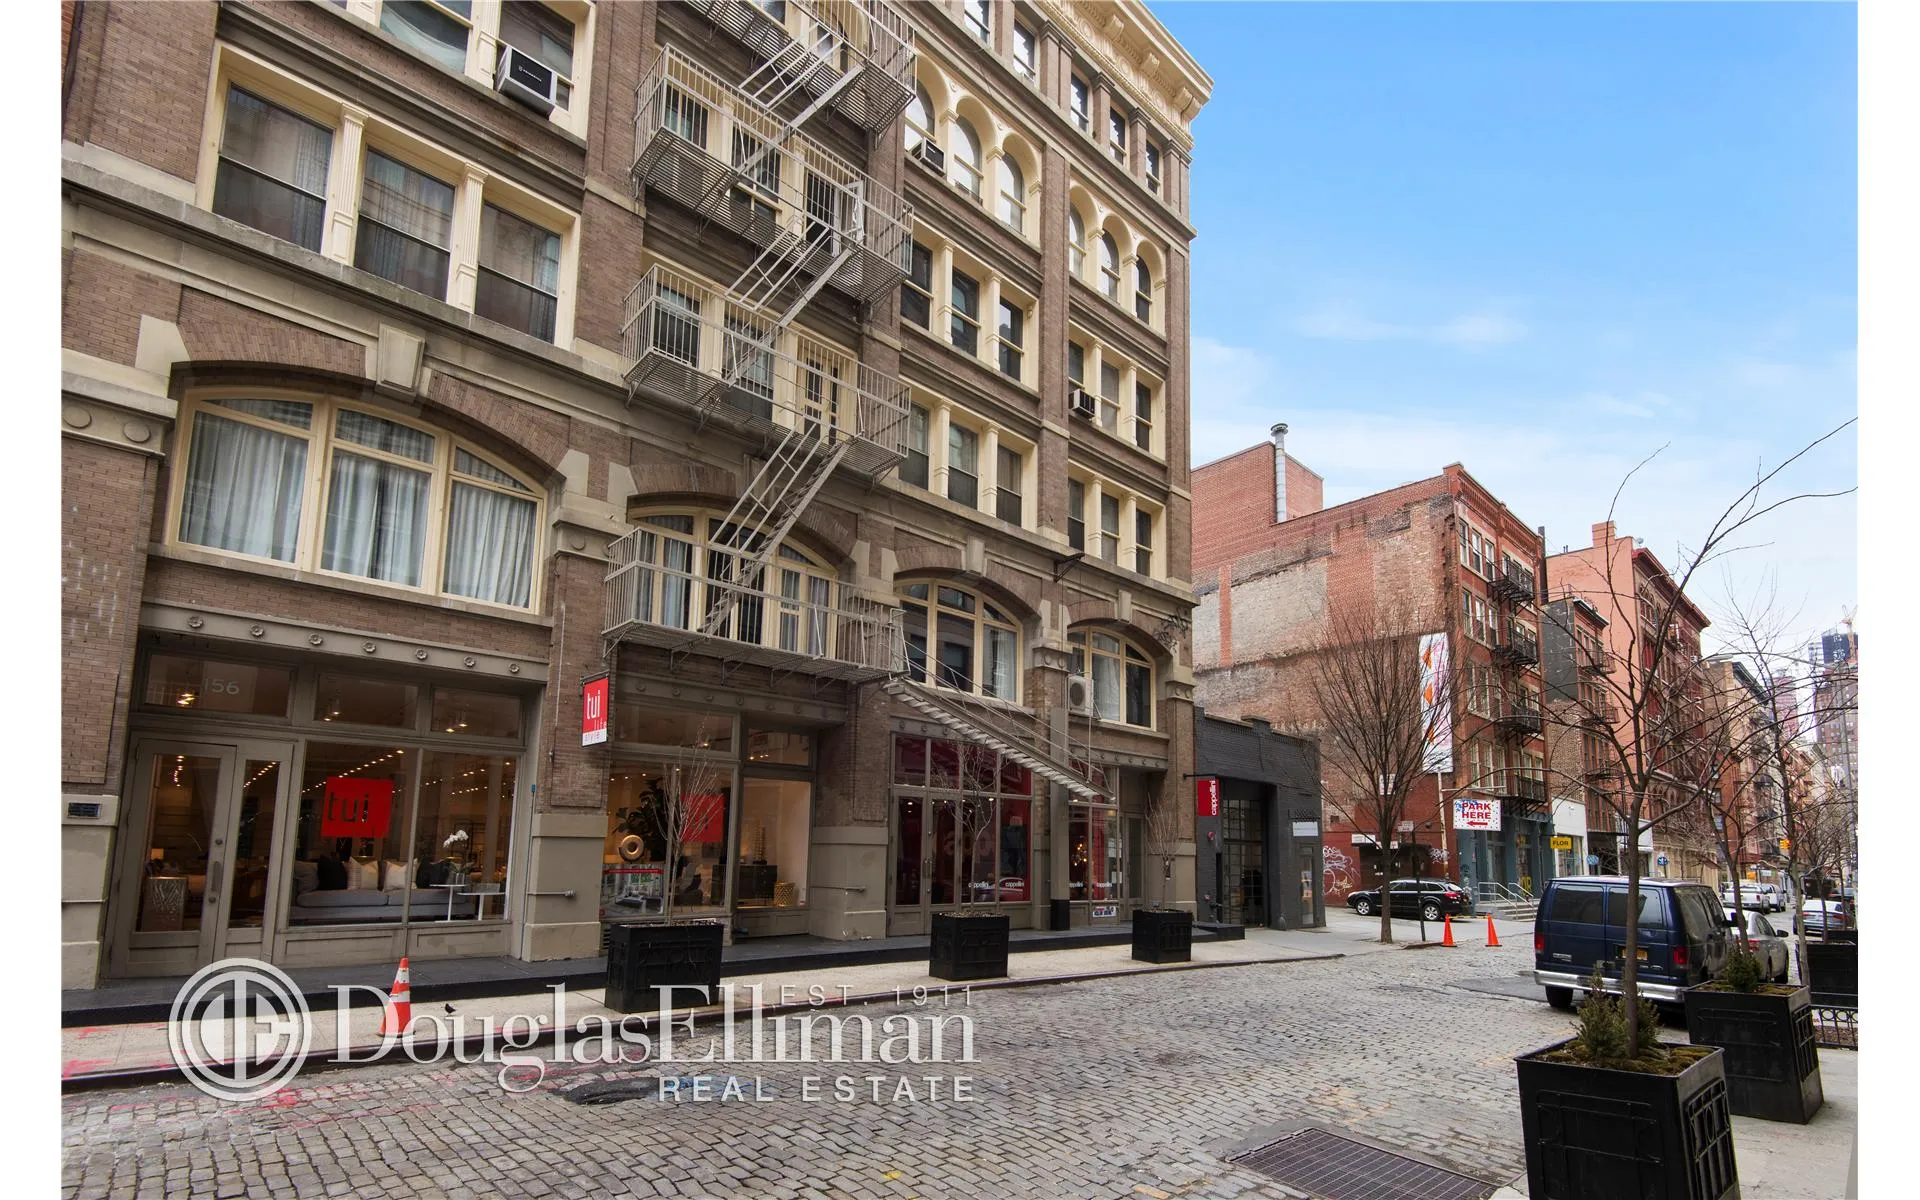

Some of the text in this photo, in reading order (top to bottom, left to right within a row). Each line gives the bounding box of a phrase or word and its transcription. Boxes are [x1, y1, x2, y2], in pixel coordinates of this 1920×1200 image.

[204, 678, 240, 695] 156
[587, 689, 601, 720] tui
[327, 792, 369, 823] tui
[1209, 778, 1218, 816] cappellini
[1461, 802, 1492, 811] PARK
[1461, 811, 1492, 820] HERE
